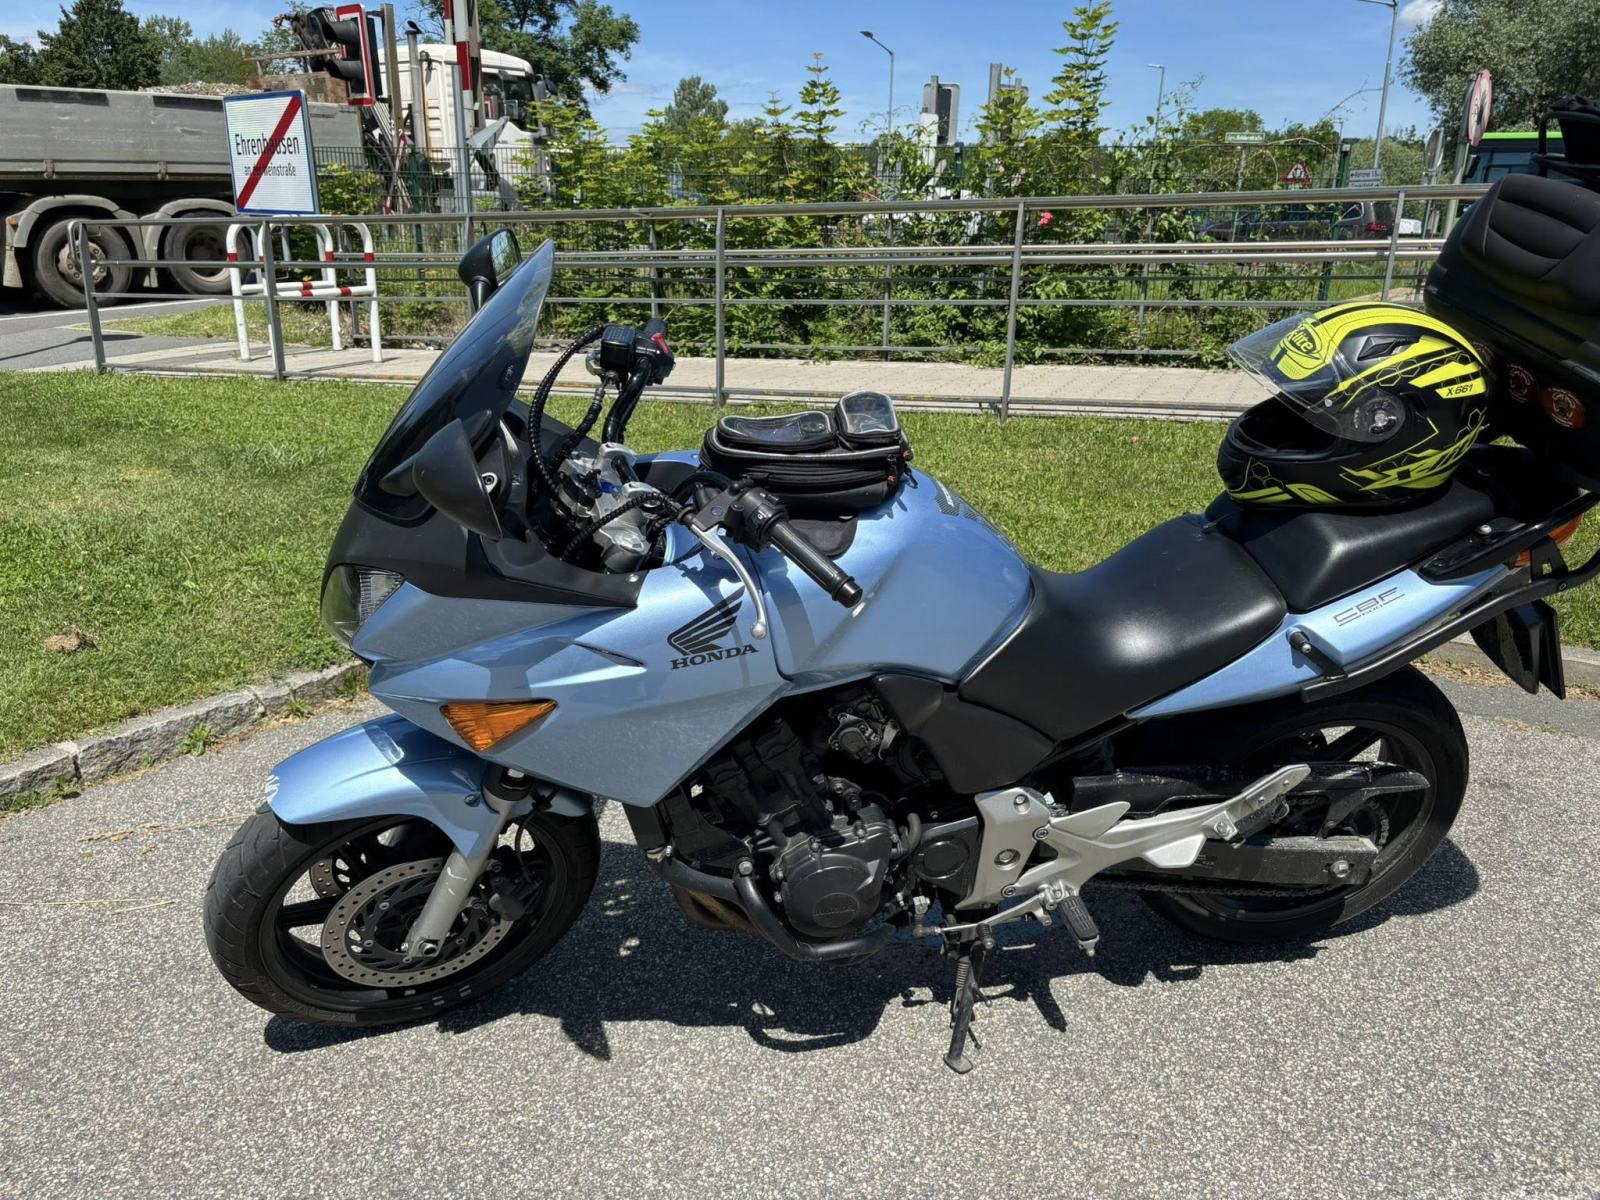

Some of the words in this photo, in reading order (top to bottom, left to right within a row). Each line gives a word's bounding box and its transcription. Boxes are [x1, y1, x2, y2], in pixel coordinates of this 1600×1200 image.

[235, 133, 300, 155] Ehrenhausen
[244, 165, 251, 176] an
[1333, 587, 1398, 623] CBF
[670, 644, 759, 670] HONDA
